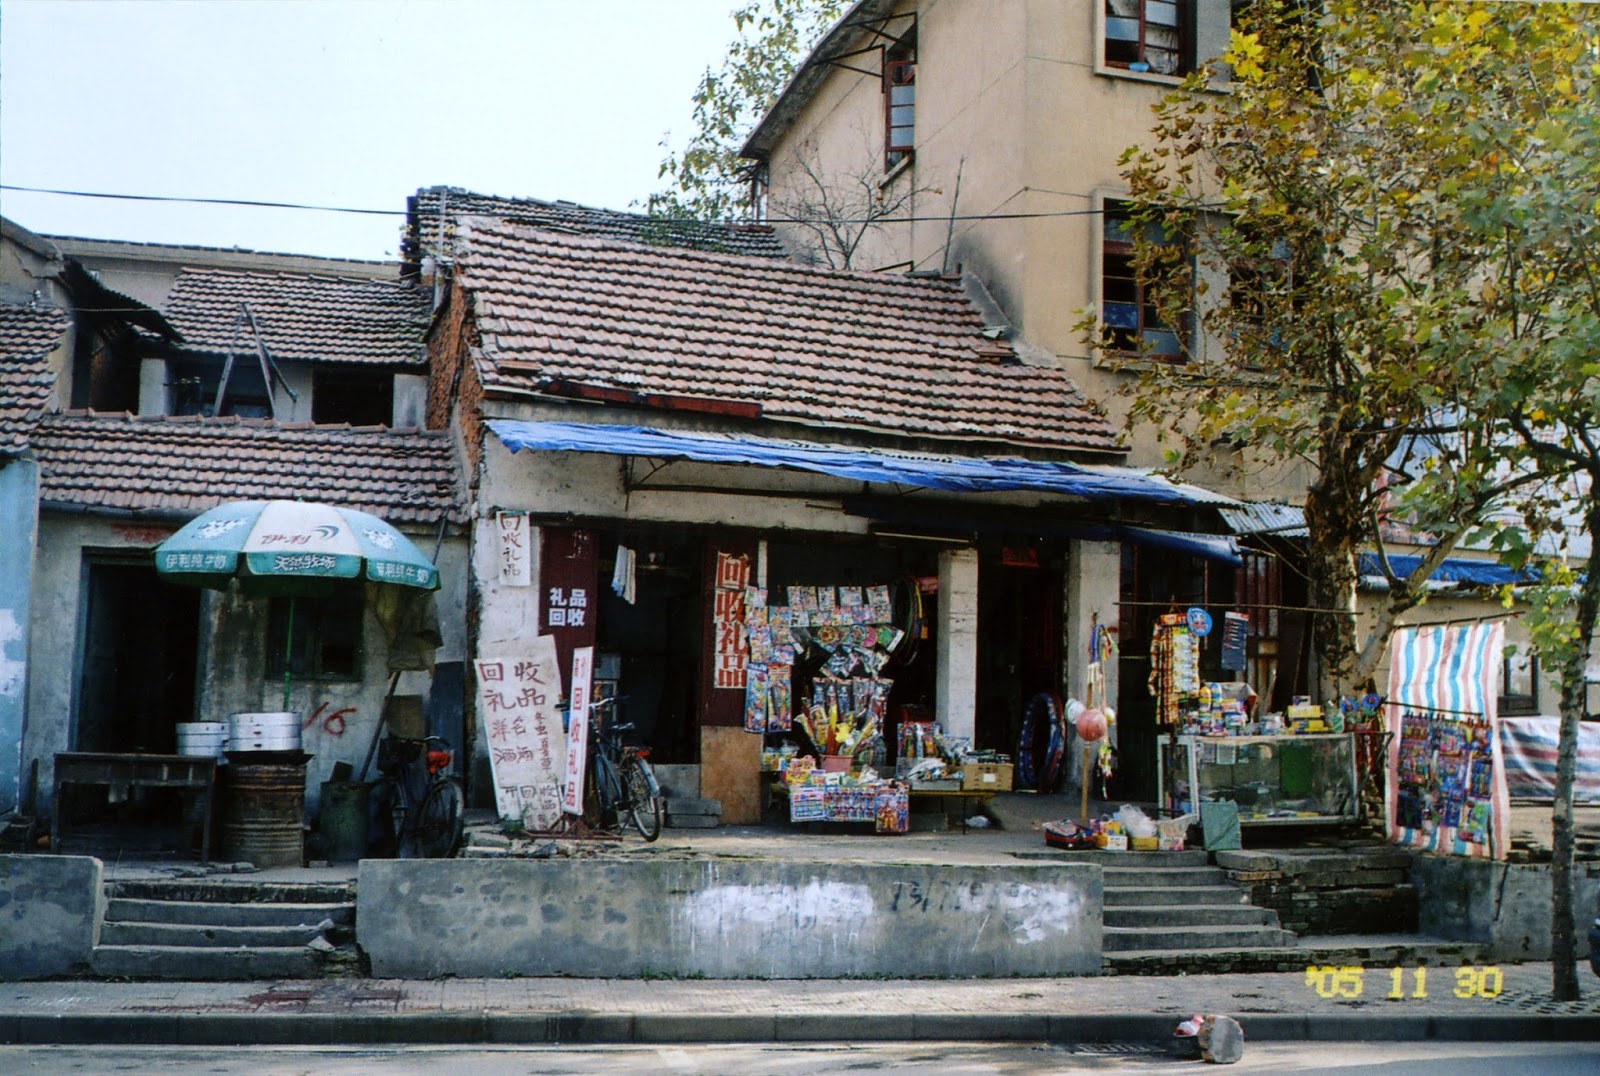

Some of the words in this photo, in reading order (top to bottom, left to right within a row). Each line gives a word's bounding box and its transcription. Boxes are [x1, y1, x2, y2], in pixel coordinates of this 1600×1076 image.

[261, 535, 312, 545] 伊利
[499, 511, 522, 576] 回收礼品
[165, 553, 227, 570] 伊利纯牛奶
[274, 554, 336, 571] 天然牧场
[549, 587, 587, 607] 礼品
[548, 607, 585, 626] 回收
[715, 551, 748, 688] 回收礼品
[478, 661, 546, 685] 回收
[483, 688, 546, 712] 礼品
